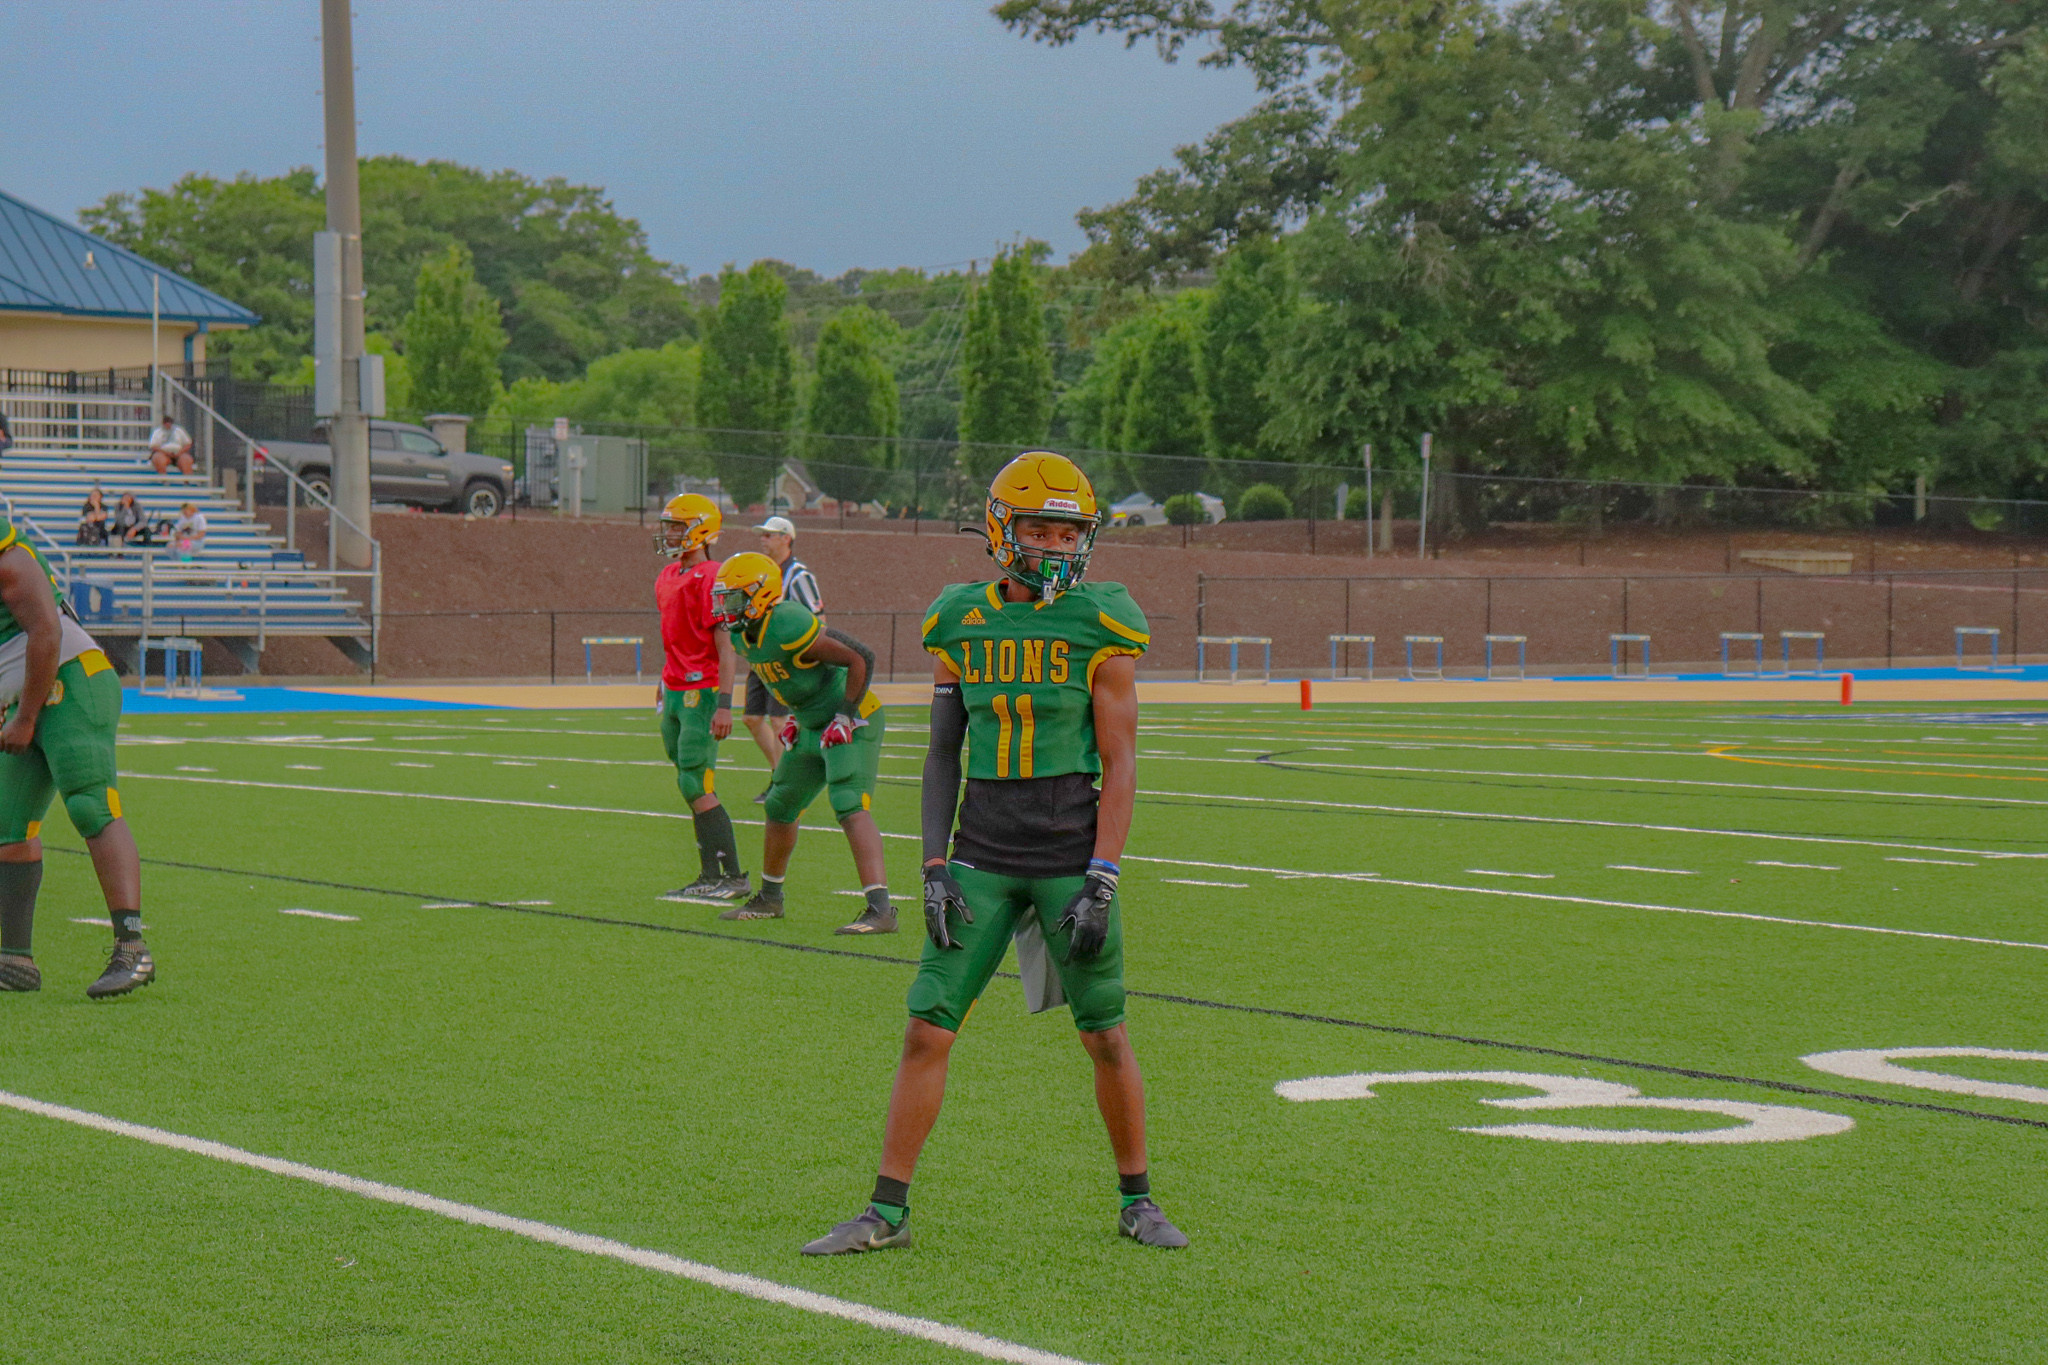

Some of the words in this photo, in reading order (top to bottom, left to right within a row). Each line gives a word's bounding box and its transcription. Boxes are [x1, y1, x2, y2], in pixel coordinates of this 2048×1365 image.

[1049, 500, 1077, 509] Riddell
[960, 639, 1070, 684] LIONS
[992, 693, 1034, 778] 11
